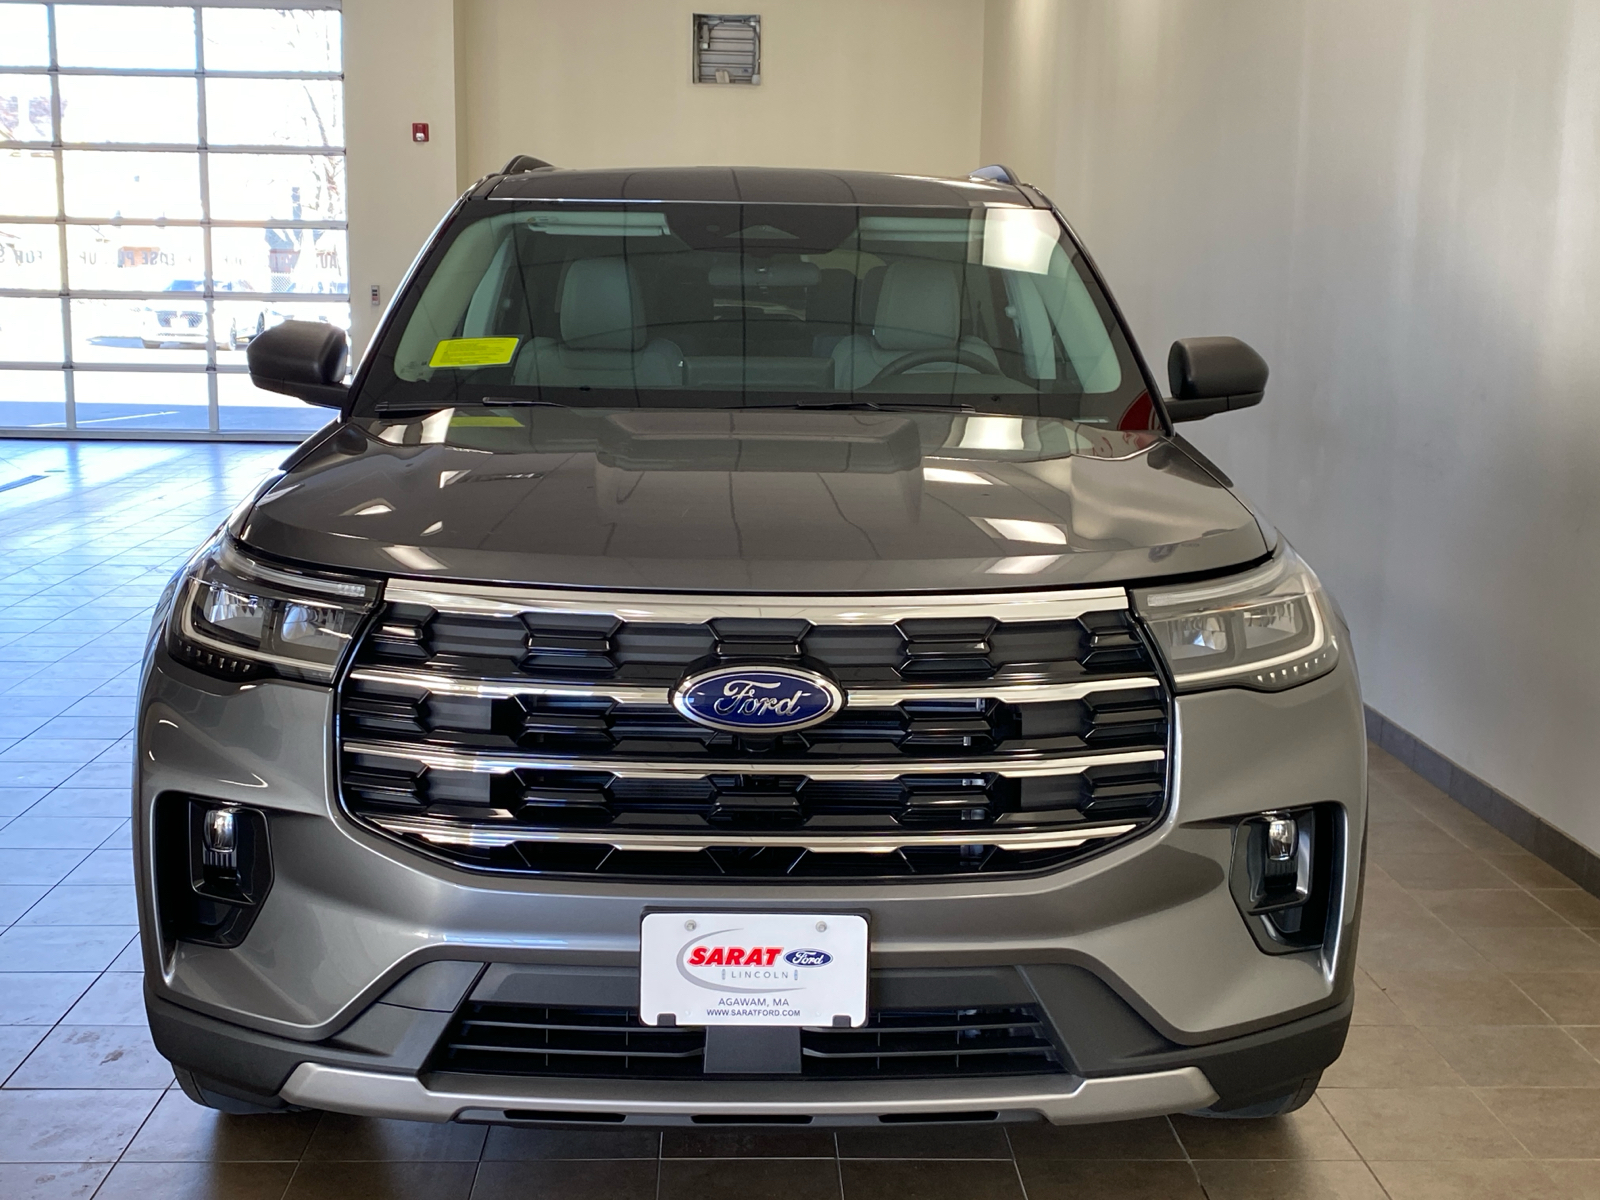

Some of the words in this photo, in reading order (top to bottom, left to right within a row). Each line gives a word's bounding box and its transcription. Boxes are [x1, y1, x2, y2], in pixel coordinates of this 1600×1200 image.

[713, 679, 801, 717] Ford
[688, 946, 784, 967] SARAT
[791, 950, 824, 965] Ford
[731, 971, 789, 979] LINCOLN
[718, 998, 770, 1008] AGAWAM,
[773, 998, 790, 1007] MA
[706, 1008, 801, 1018] WWW.SARATFORD.COM
